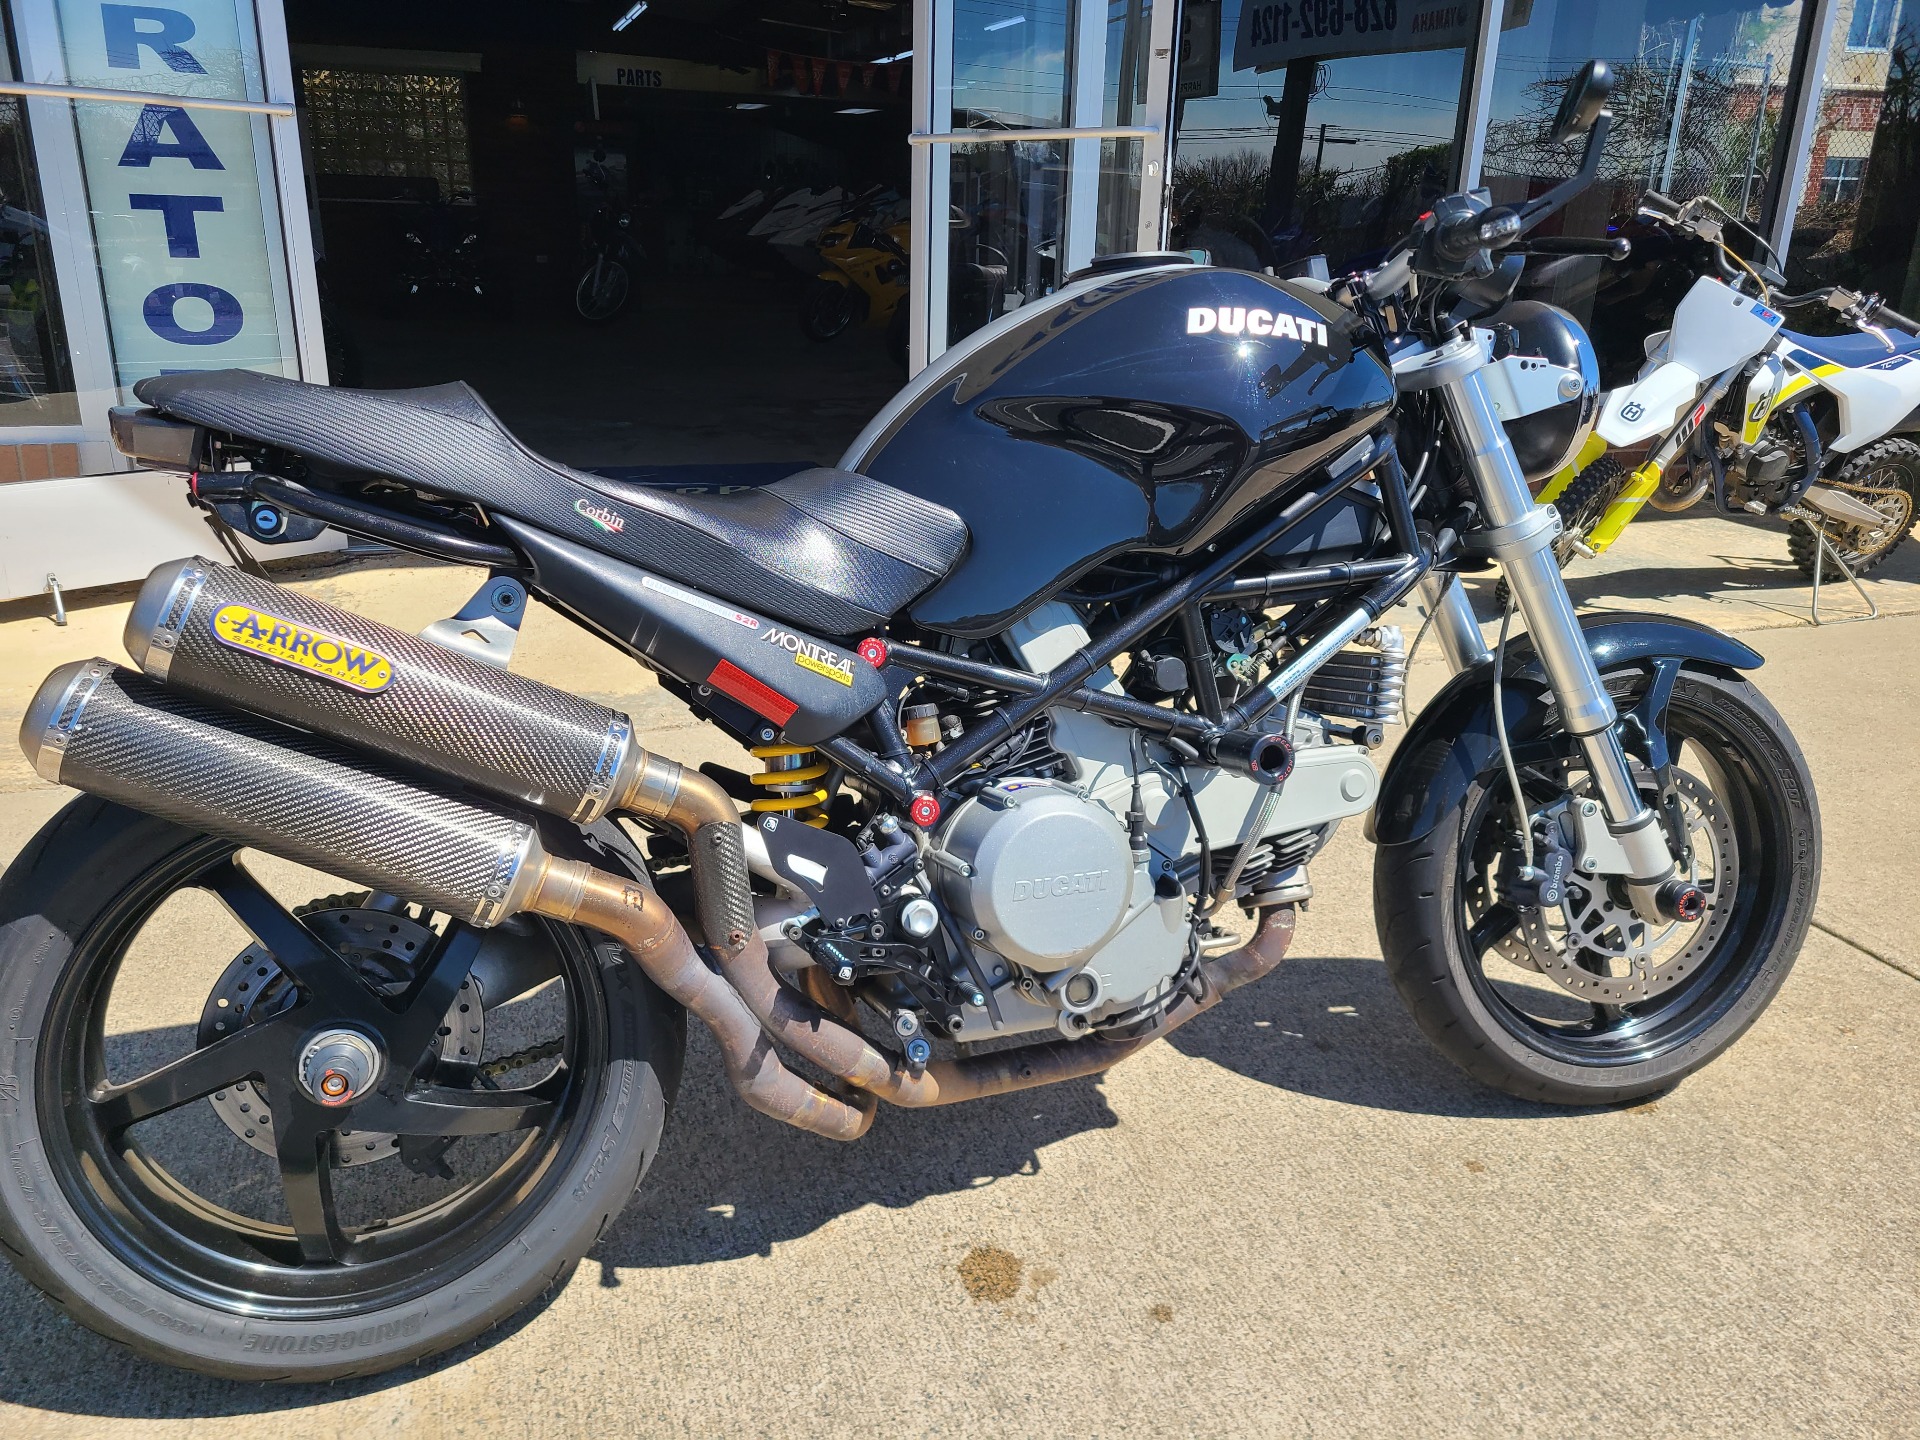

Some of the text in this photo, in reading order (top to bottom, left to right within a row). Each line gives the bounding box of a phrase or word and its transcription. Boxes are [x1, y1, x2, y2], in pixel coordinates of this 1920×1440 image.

[616, 68, 662, 87] PARTS
[101, 4, 244, 376] RATO
[1187, 307, 1328, 347] DUCATI
[576, 499, 625, 529] Corbin
[735, 613, 758, 628] S2R
[231, 612, 382, 676] ARROW
[231, 635, 368, 685] SPECIAL PARTS
[761, 627, 854, 675] MONTREAL
[797, 655, 851, 684] powersports
[1012, 870, 1109, 902] DUCATI
[1550, 855, 1564, 889] brembo
[243, 1311, 424, 1355] BRIDGESTONE
